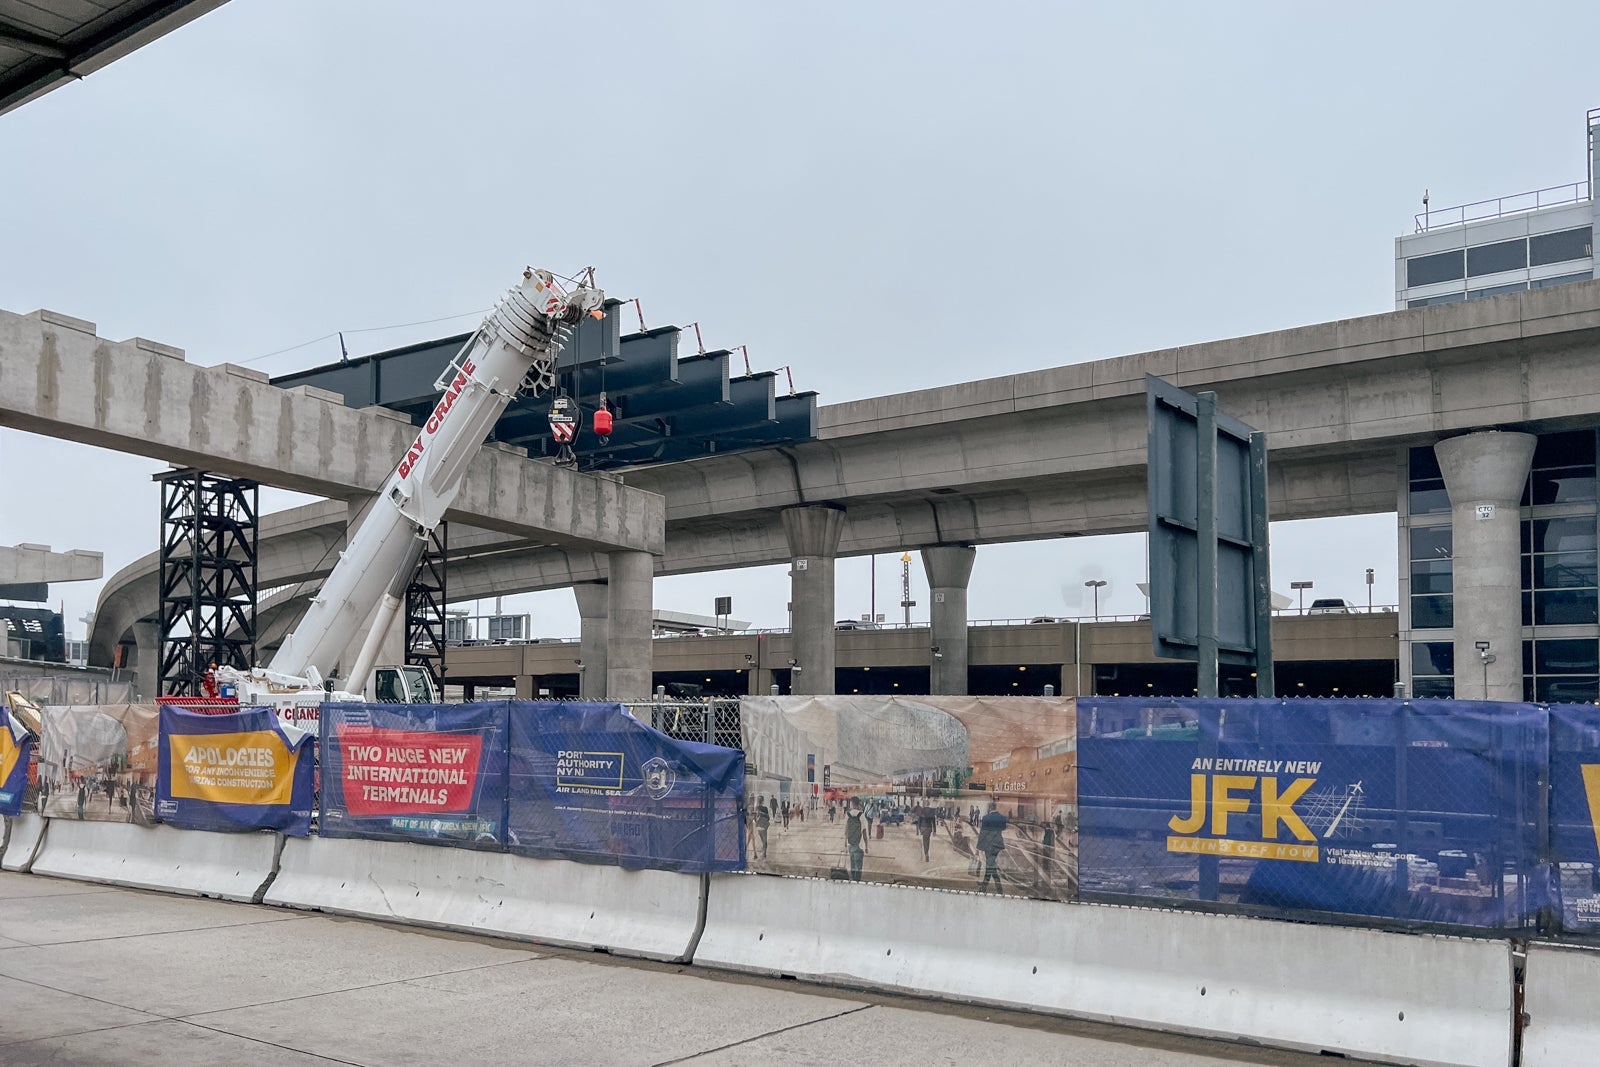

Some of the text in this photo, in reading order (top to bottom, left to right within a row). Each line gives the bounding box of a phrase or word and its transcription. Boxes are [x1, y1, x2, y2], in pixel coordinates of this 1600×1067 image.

[398, 358, 476, 479] BAY CRANE
[284, 708, 320, 720] CANE
[184, 746, 275, 767] APOLOGIES
[348, 746, 467, 764] TWO HUGE NEW
[557, 750, 583, 759] PORT
[557, 759, 613, 769] AUTHORITY
[1191, 757, 1322, 774] AN ENTIRELY NEW
[202, 766, 216, 776] ANY
[216, 767, 276, 778] INCONVENIENCE
[347, 765, 467, 785] INTERNATIONAL
[557, 768, 573, 776] NY
[218, 778, 273, 788] CONSTRUCTION
[362, 785, 448, 805] TERMINALS
[1168, 773, 1318, 842] JFK
[392, 819, 408, 828] PART
[409, 819, 418, 828] OF
[1172, 839, 1314, 858] TAKING OFF NOW
[1326, 848, 1346, 857] Visit
[1339, 856, 1363, 865] learn
[1364, 859, 1392, 868] more.
